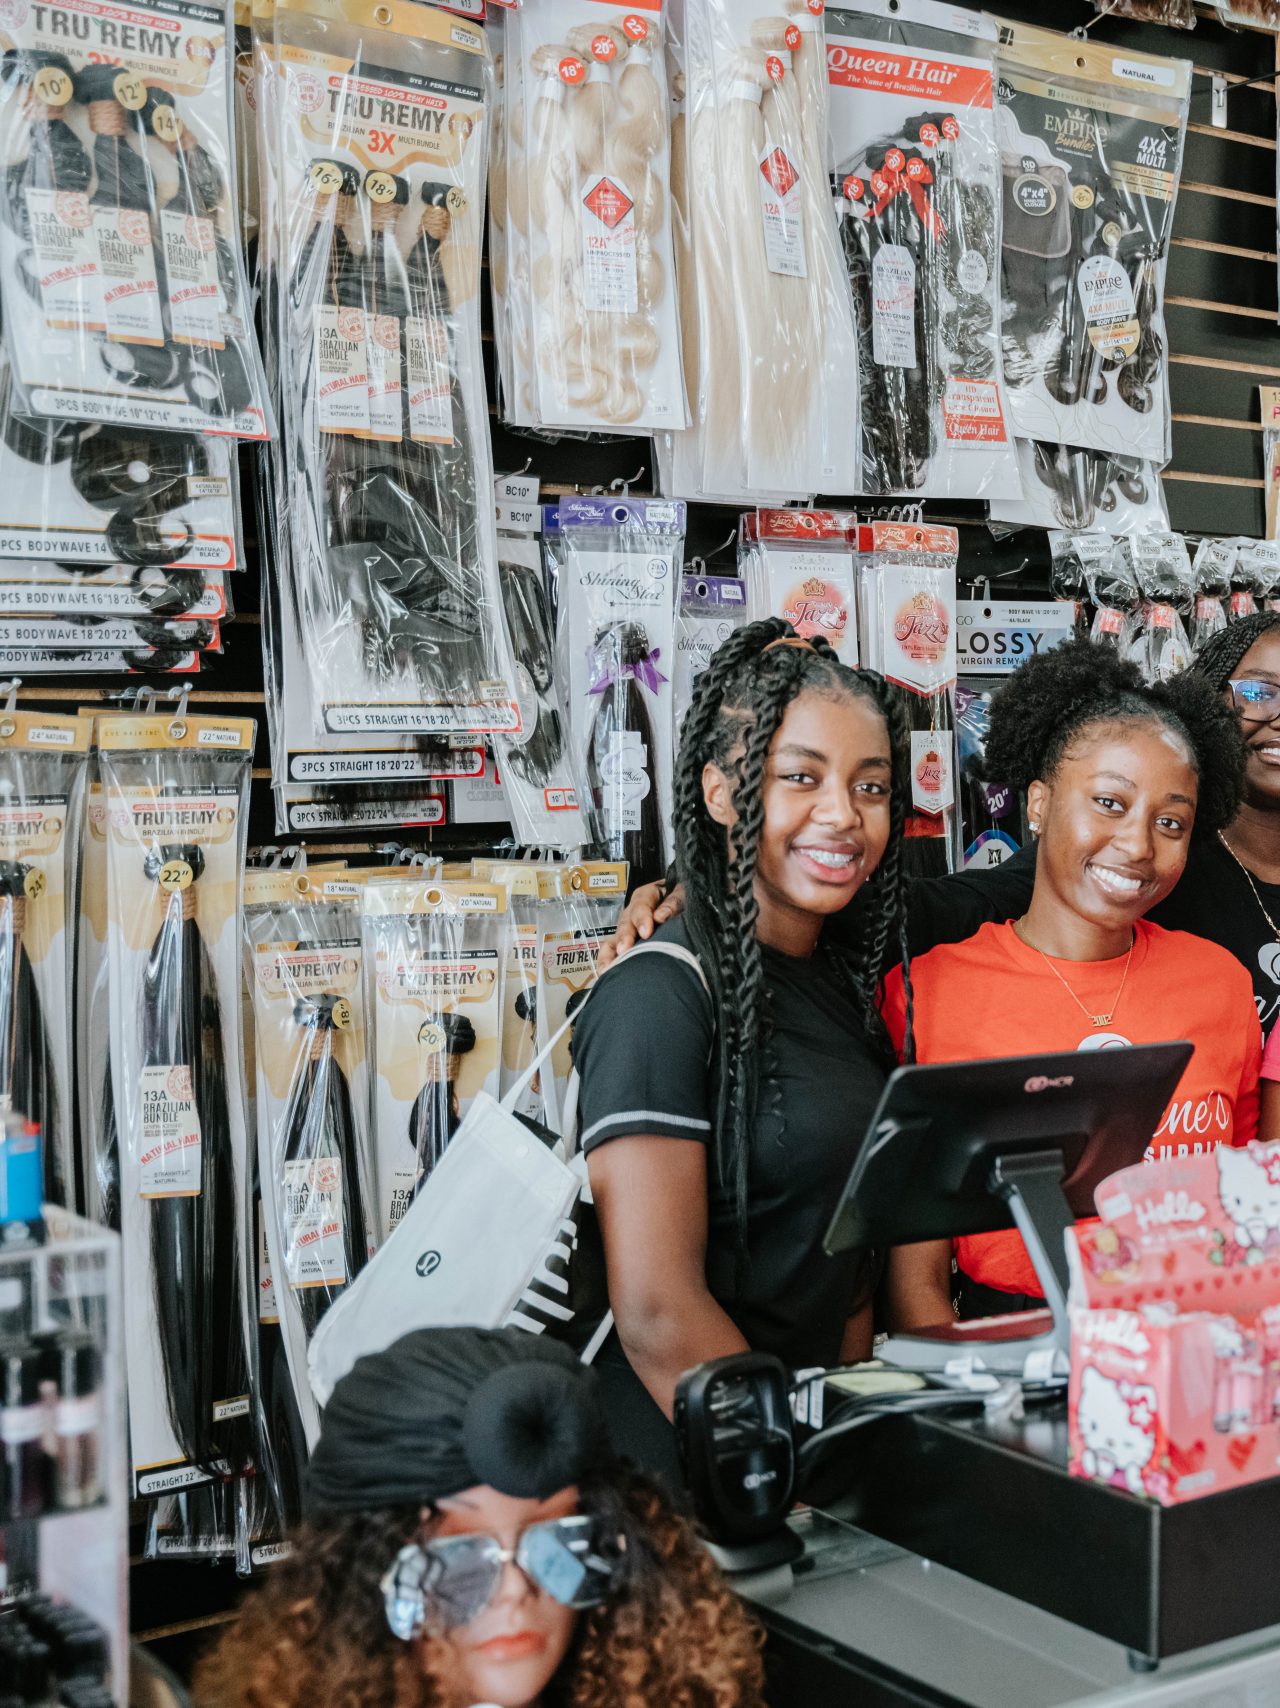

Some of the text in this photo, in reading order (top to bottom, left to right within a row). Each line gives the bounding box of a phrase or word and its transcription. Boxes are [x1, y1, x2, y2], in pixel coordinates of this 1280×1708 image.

[31, 5, 182, 59] TRU REMY
[827, 47, 957, 85] Queen Hair
[1122, 68, 1156, 82] NATURAL
[848, 74, 942, 96] The Name of Brazilian Hair
[328, 90, 446, 134] TRU REMY
[367, 129, 396, 156] 3X
[1138, 136, 1167, 156] 4X4
[1136, 153, 1167, 169] MULTI
[98, 229, 120, 241] 13A
[165, 232, 187, 245] 13A
[319, 327, 339, 340] 13A
[200, 550, 220, 558] BLACK
[579, 571, 641, 589] Shining
[896, 614, 949, 643] Jazz
[961, 657, 1020, 665] VIRGIN REMY
[216, 734, 238, 742] NATURAL
[302, 762, 325, 772] 3PCS
[330, 761, 373, 772] STRAIGHT
[133, 810, 216, 825] TRU REMY
[297, 812, 316, 822] 3PCS
[556, 953, 574, 966] TRU
[143, 1090, 168, 1101] 13A
[143, 1101, 191, 1113] BRAZILIAN
[1135, 1190, 1206, 1231] Hello
[231, 1404, 247, 1412] NATURAL
[147, 1476, 183, 1491] STRAIGHT
